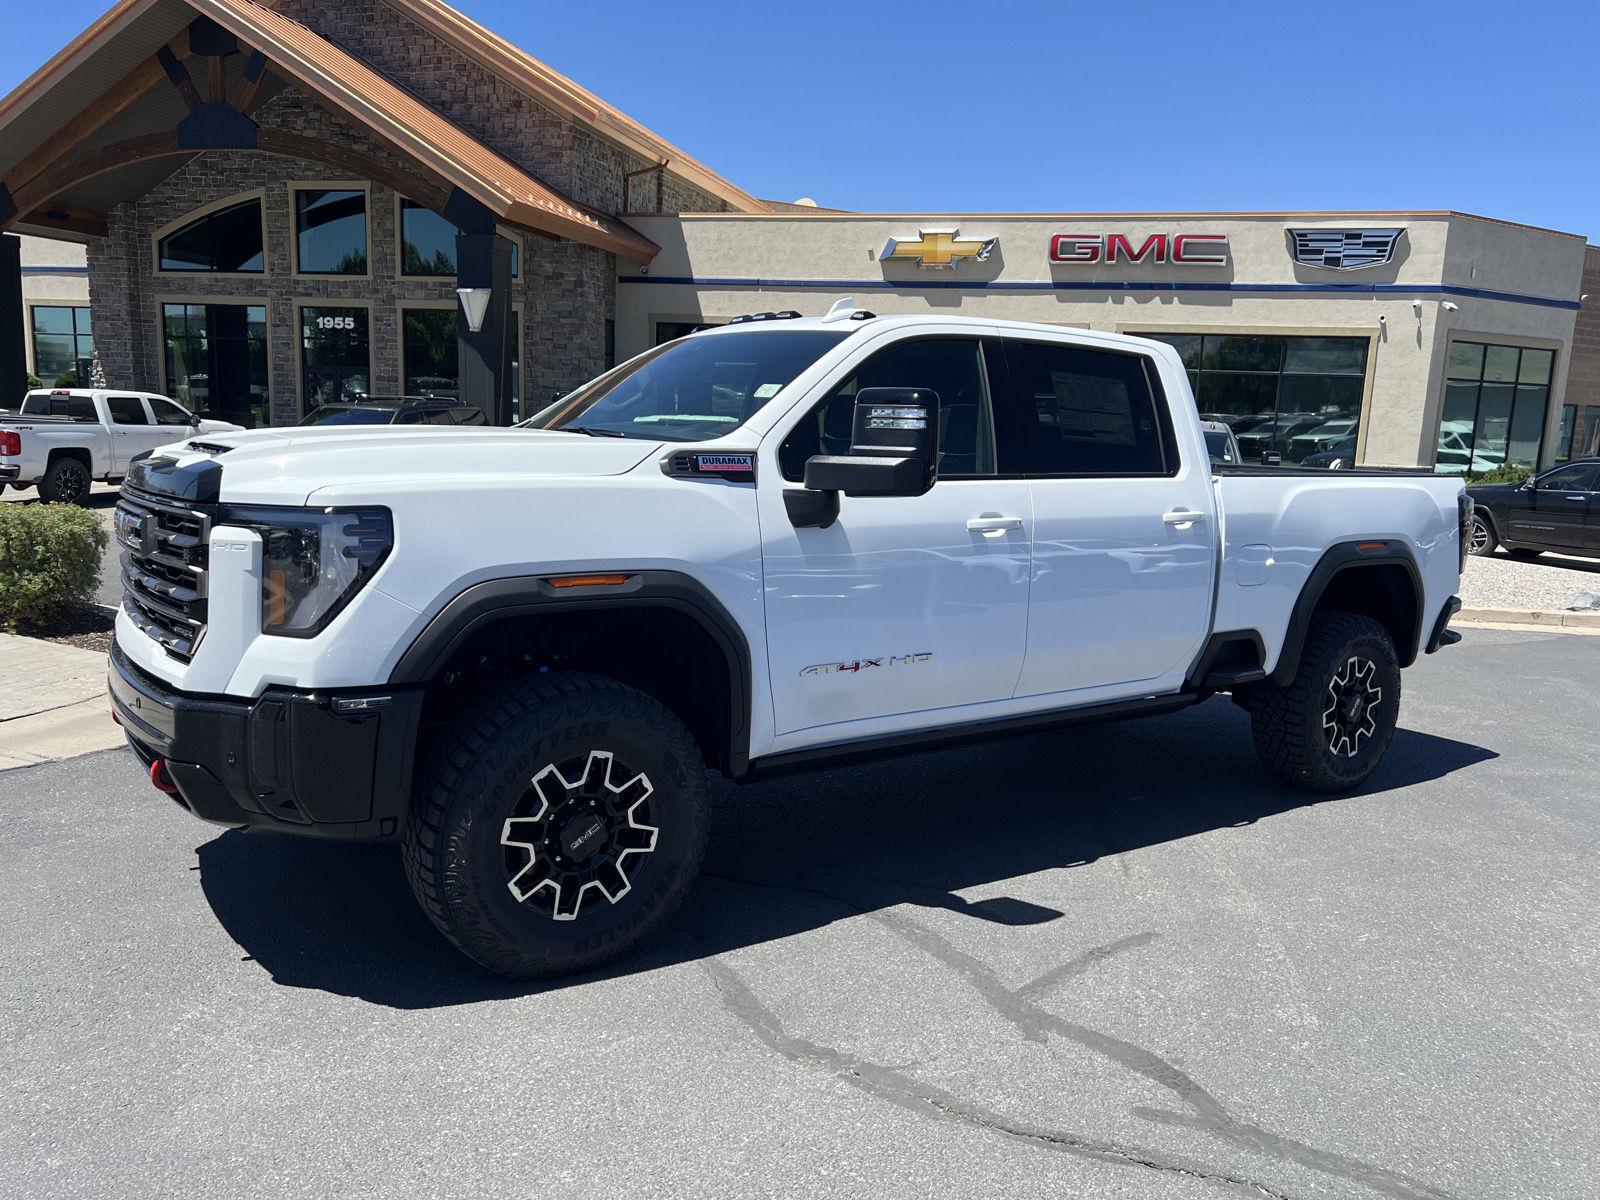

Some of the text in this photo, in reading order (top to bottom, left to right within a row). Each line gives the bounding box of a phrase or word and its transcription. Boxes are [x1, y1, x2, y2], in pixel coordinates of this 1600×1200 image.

[1049, 232, 1229, 267] GMC
[316, 316, 355, 330] 1955
[702, 456, 748, 465] DURAMAX
[569, 823, 601, 851] GMC
